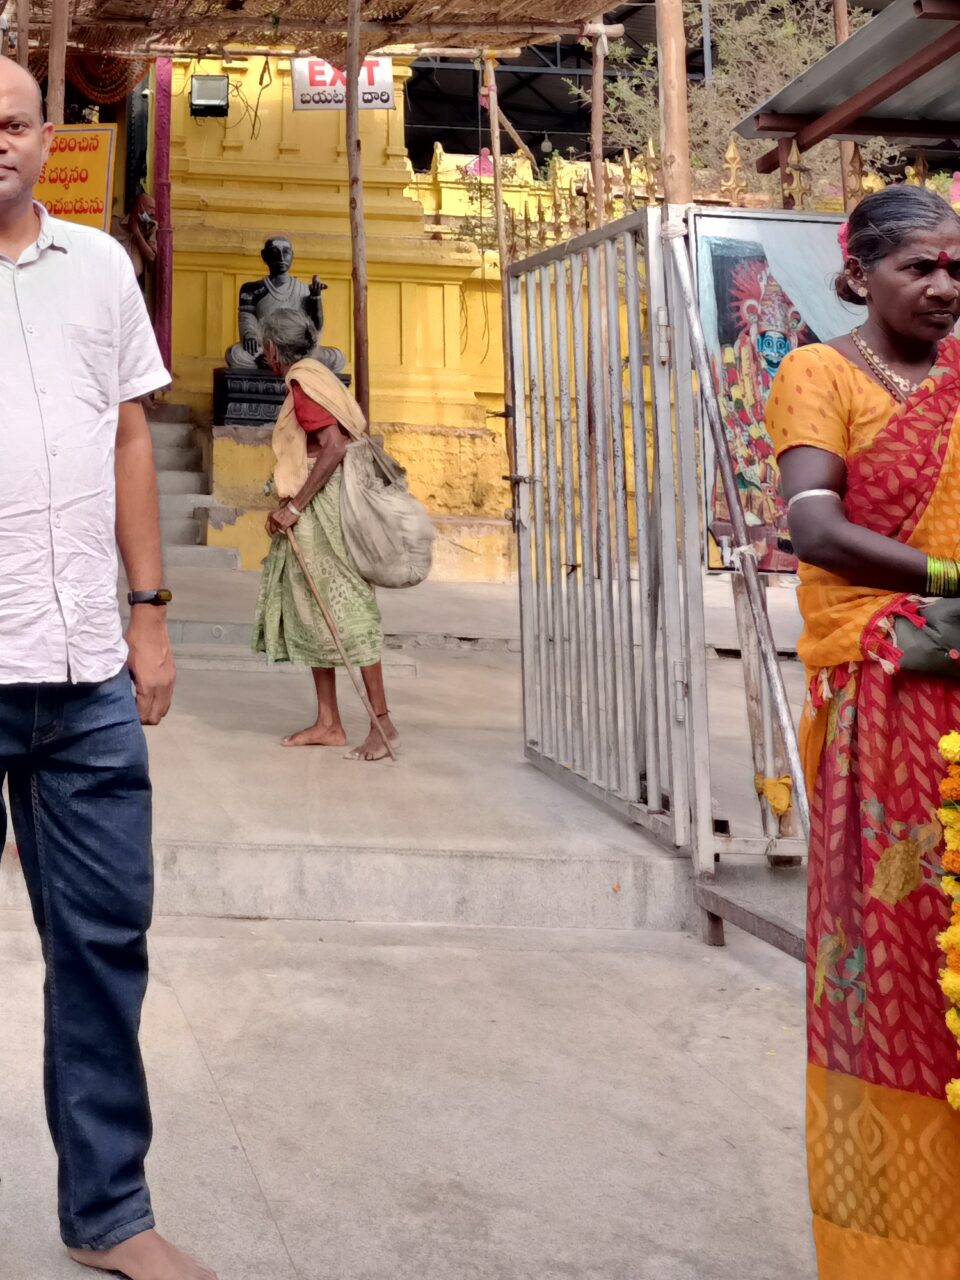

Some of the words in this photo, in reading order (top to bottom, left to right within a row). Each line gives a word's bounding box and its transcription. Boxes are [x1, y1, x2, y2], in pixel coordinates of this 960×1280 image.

[308, 60, 379, 86] EXT
[300, 90, 347, 104] బయట
[362, 91, 390, 103] దారి
